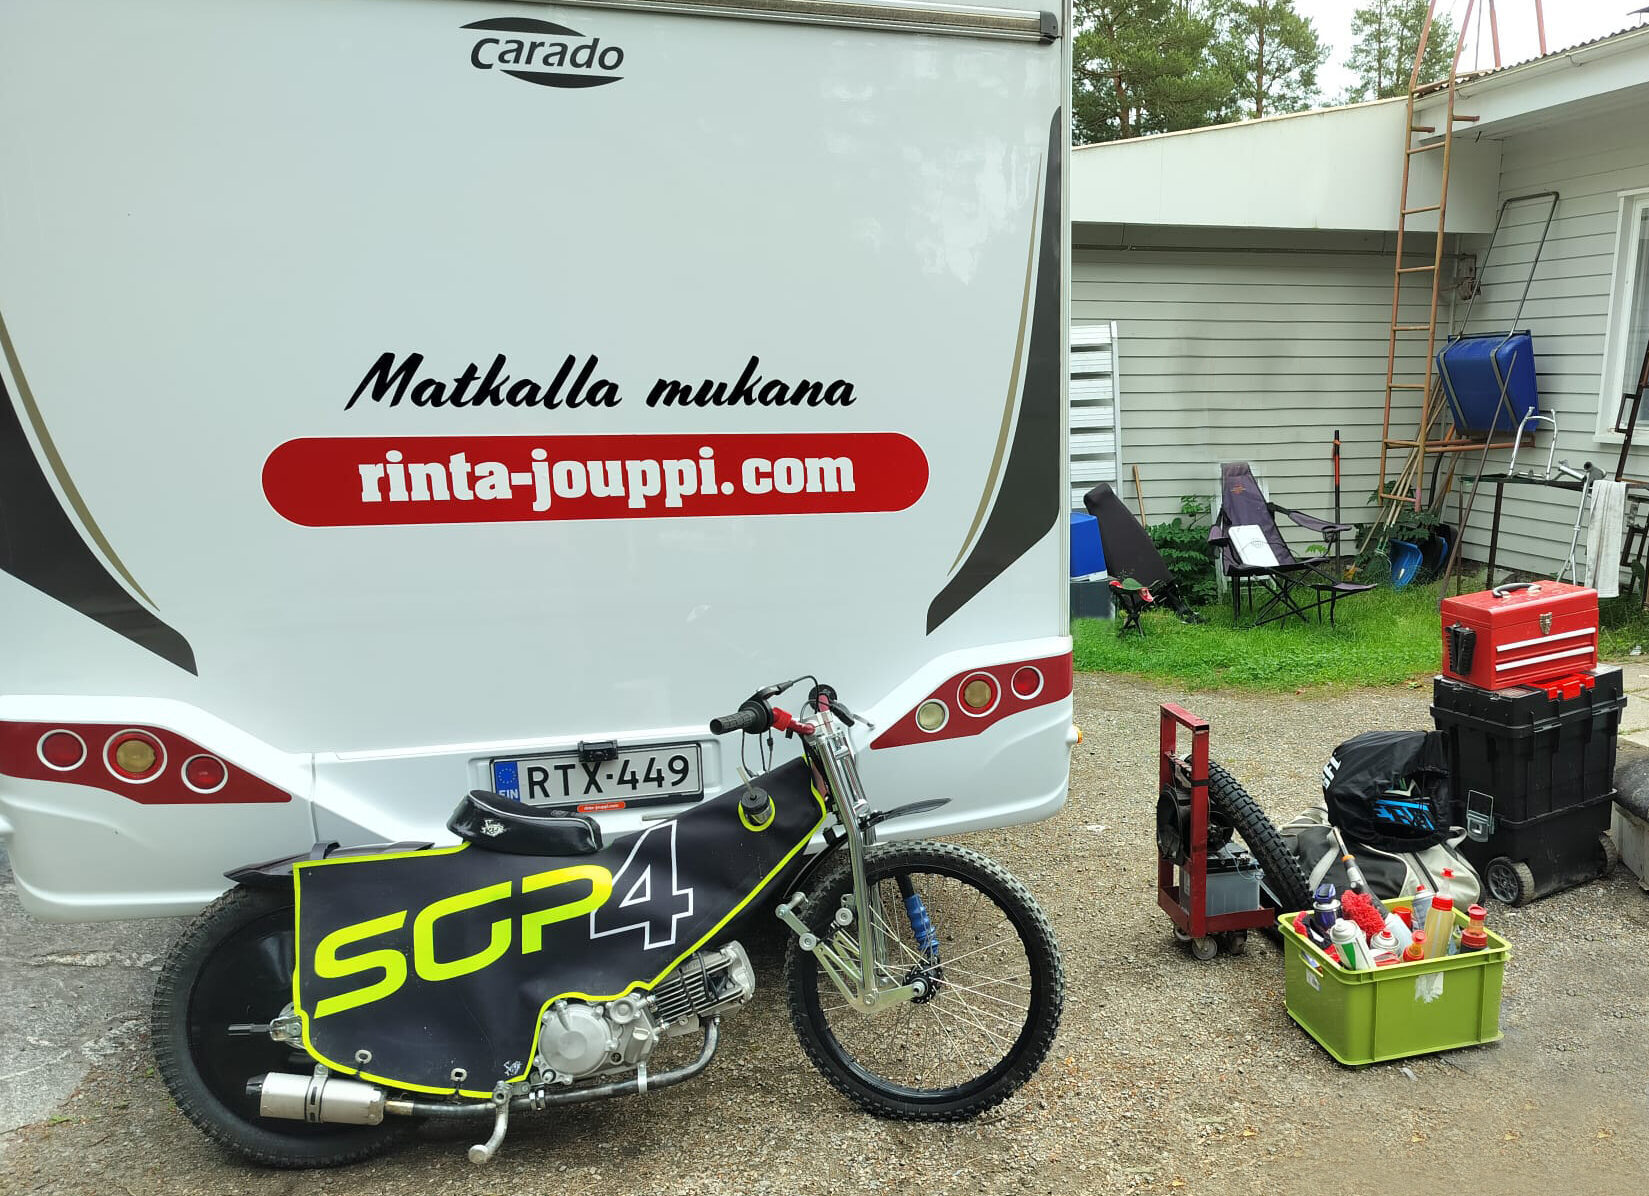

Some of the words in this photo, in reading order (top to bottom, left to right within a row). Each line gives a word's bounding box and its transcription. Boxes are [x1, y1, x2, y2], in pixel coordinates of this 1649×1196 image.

[344, 352, 622, 410] Matkalla
[646, 356, 856, 408] mukana
[358, 446, 856, 512] rinta-jouppi.com
[527, 755, 690, 799] RTX-449
